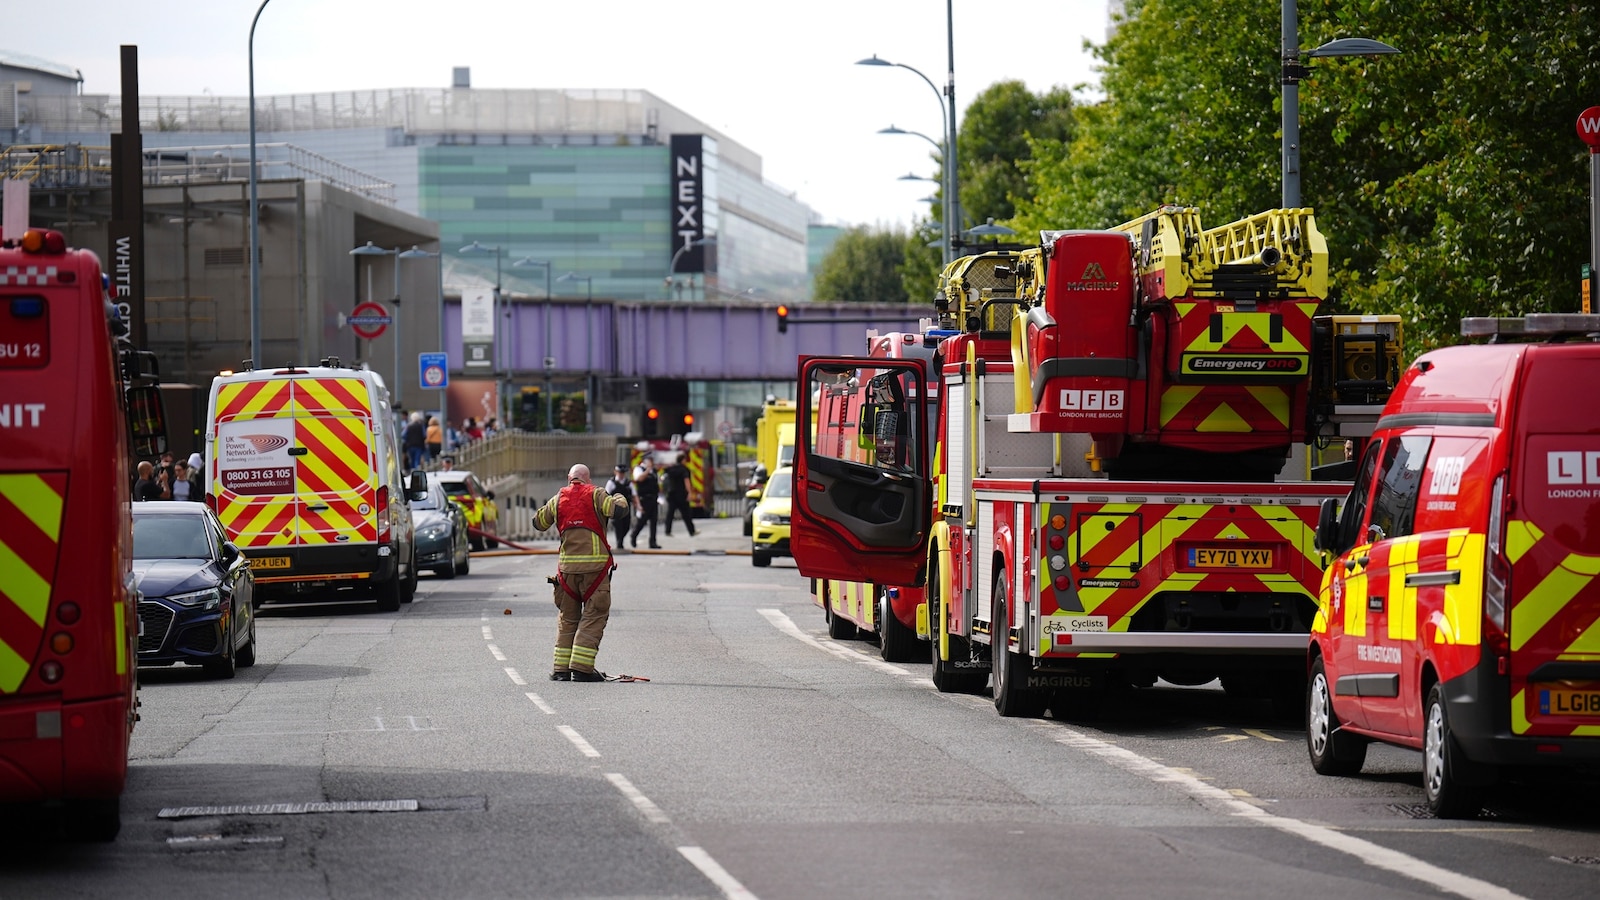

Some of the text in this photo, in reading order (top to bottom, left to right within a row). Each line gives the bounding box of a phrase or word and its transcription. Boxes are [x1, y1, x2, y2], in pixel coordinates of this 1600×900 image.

[677, 155, 698, 252] NEXT
[116, 236, 131, 297] WHITE
[1067, 281, 1119, 291] MAGIRUS
[117, 302, 131, 343] CITY
[23, 343, 41, 357] 12
[1194, 359, 1265, 370] Emergency
[1065, 392, 1120, 408] LFB
[227, 469, 291, 481] 0800 31 63 105
[1548, 489, 1591, 498] LONDON
[269, 558, 286, 567] UEN
[1198, 550, 1270, 564] EY70 YXV
[1081, 579, 1120, 588] Emergency
[1071, 619, 1104, 629] Cyclists
[1357, 644, 1367, 661] FIRE
[1027, 676, 1092, 688] MAGIRUS
